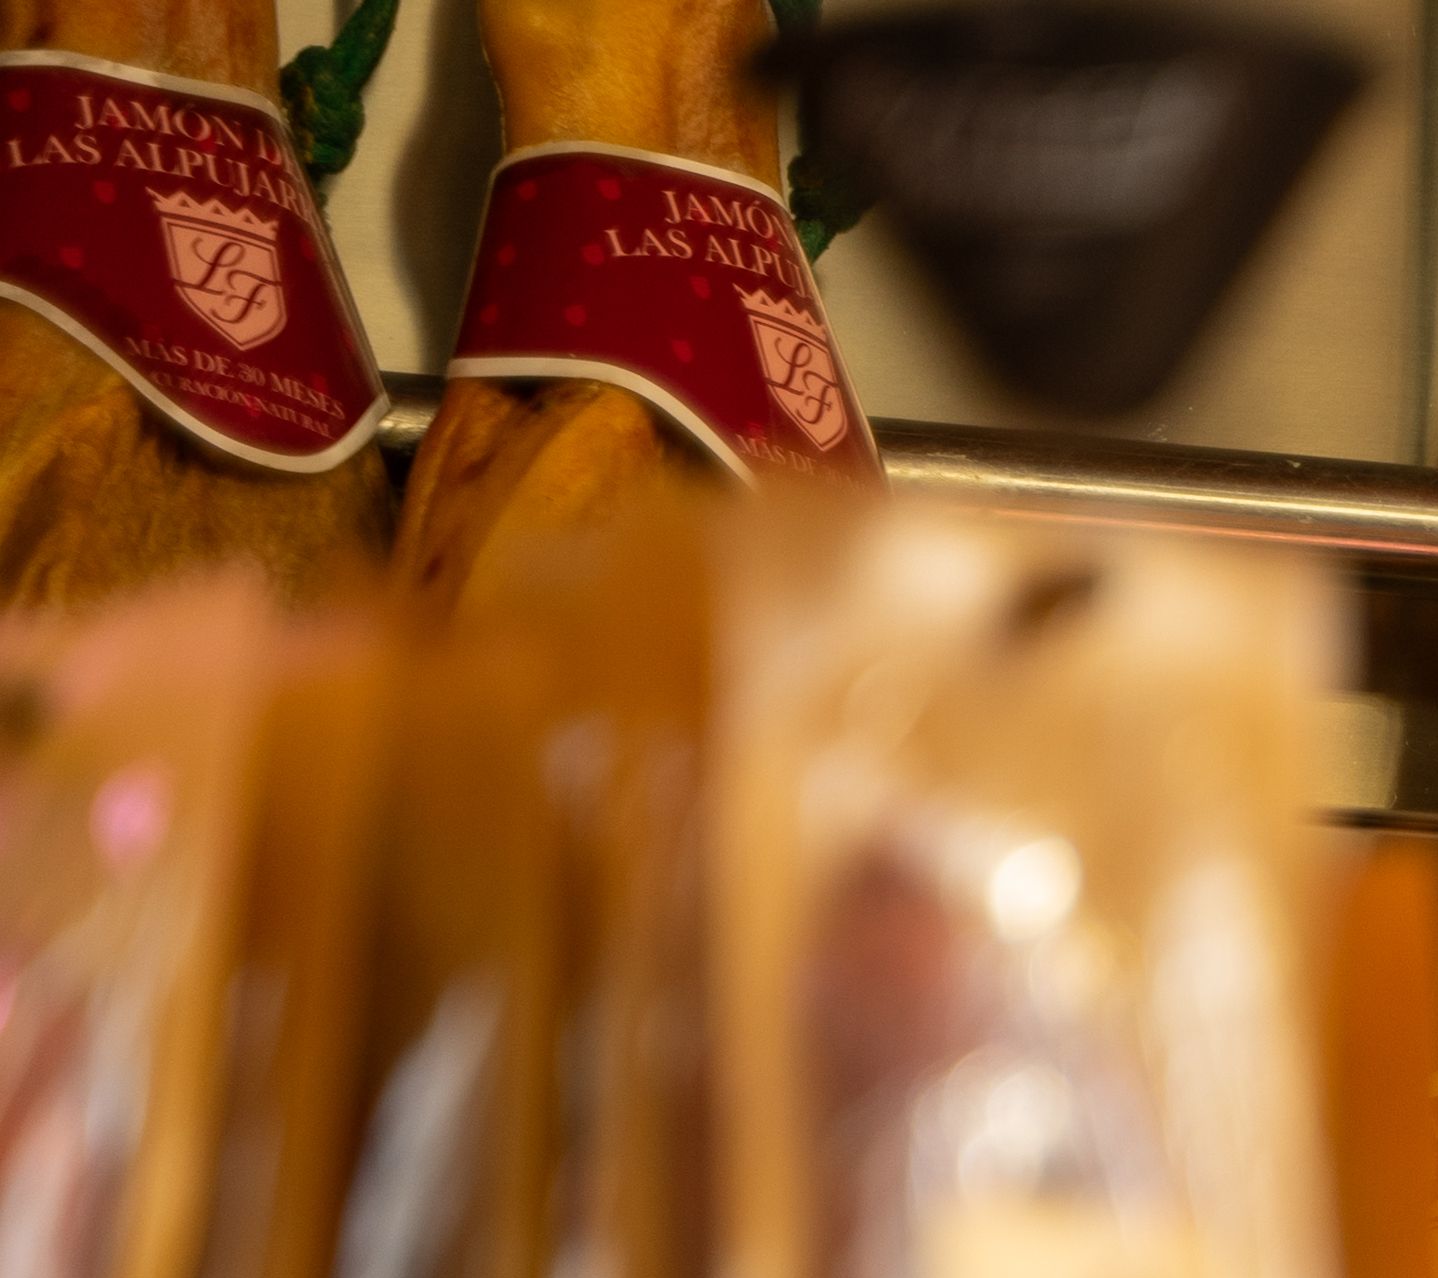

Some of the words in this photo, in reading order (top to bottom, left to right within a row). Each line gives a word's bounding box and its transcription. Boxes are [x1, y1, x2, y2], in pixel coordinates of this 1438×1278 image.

[75, 95, 244, 150] JAMÓN
[6, 133, 101, 168] LAS
[604, 229, 694, 260] LAS
[195, 349, 235, 379] DE
[270, 372, 347, 421] MESES
